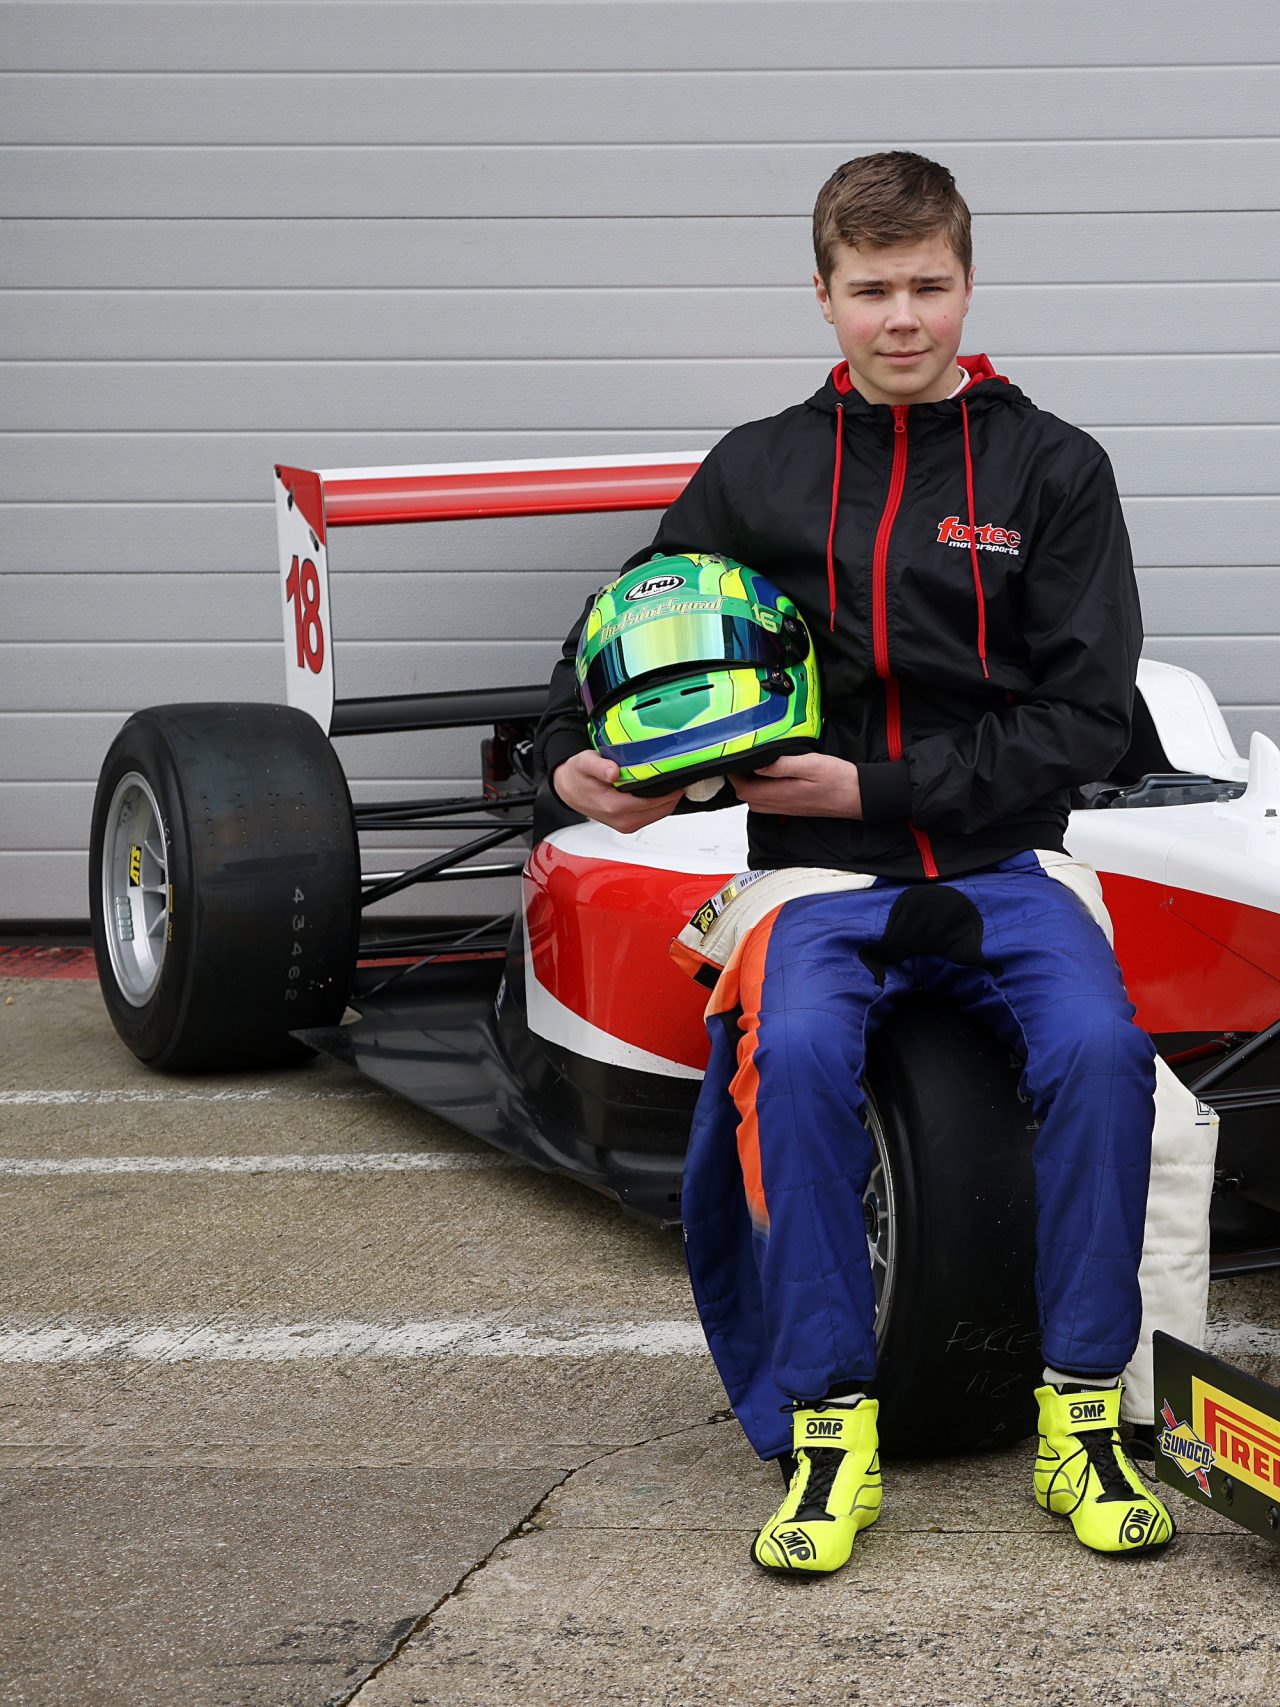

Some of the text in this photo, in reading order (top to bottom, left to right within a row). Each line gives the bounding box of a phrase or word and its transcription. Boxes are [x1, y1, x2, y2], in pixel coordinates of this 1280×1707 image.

[937, 516, 1021, 548] fotec
[629, 576, 676, 599] Arai
[286, 554, 324, 675] 18
[1070, 1403, 1105, 1419] OMP
[806, 1421, 844, 1436] OMP
[1162, 1432, 1211, 1467] SUNOCO
[1125, 1508, 1154, 1543] OMP
[778, 1531, 811, 1561] OMP
